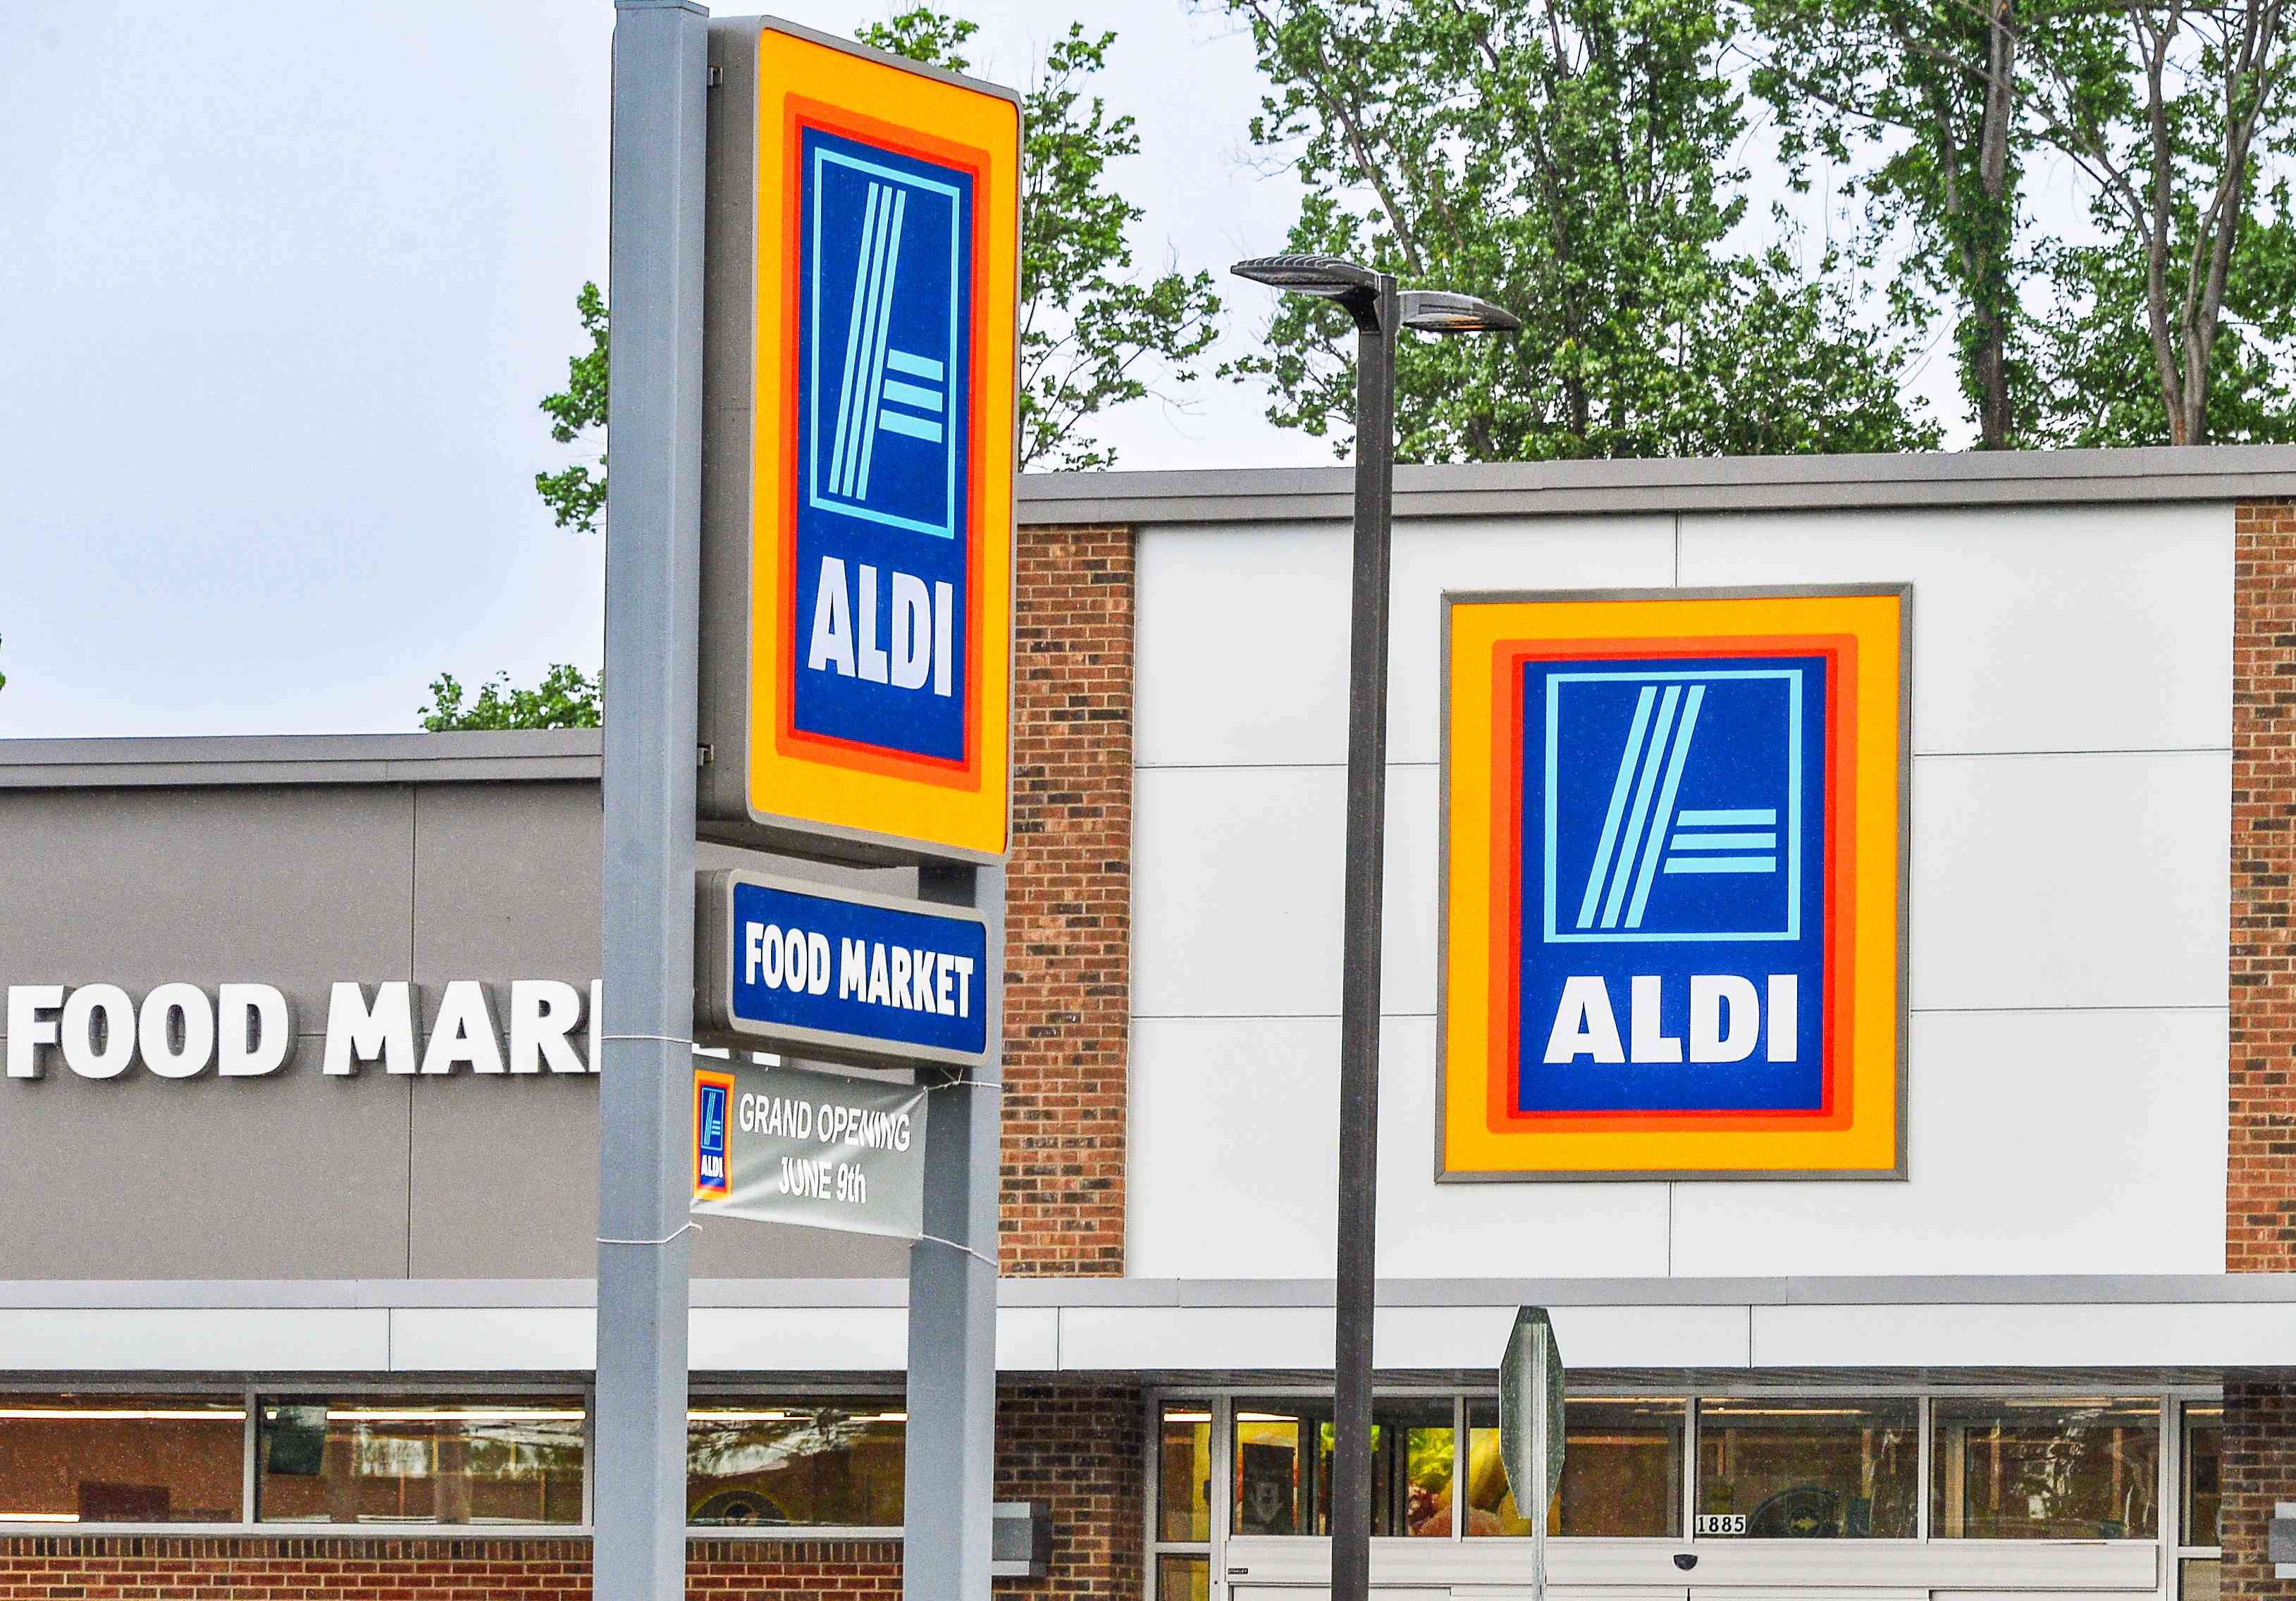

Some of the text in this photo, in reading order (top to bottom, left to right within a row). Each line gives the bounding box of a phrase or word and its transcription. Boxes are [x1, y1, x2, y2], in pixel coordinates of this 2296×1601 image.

[808, 555, 953, 697] ALDI
[746, 921, 974, 1018] FOOD MARKET
[6, 982, 289, 1078] FOOD
[1543, 974, 1798, 1063] ALDI
[739, 1093, 911, 1153] GRAND OPENING
[700, 1154, 724, 1178] ALDI
[778, 1156, 867, 1204] JUNE 9th
[1698, 1516, 1744, 1533] 1885
